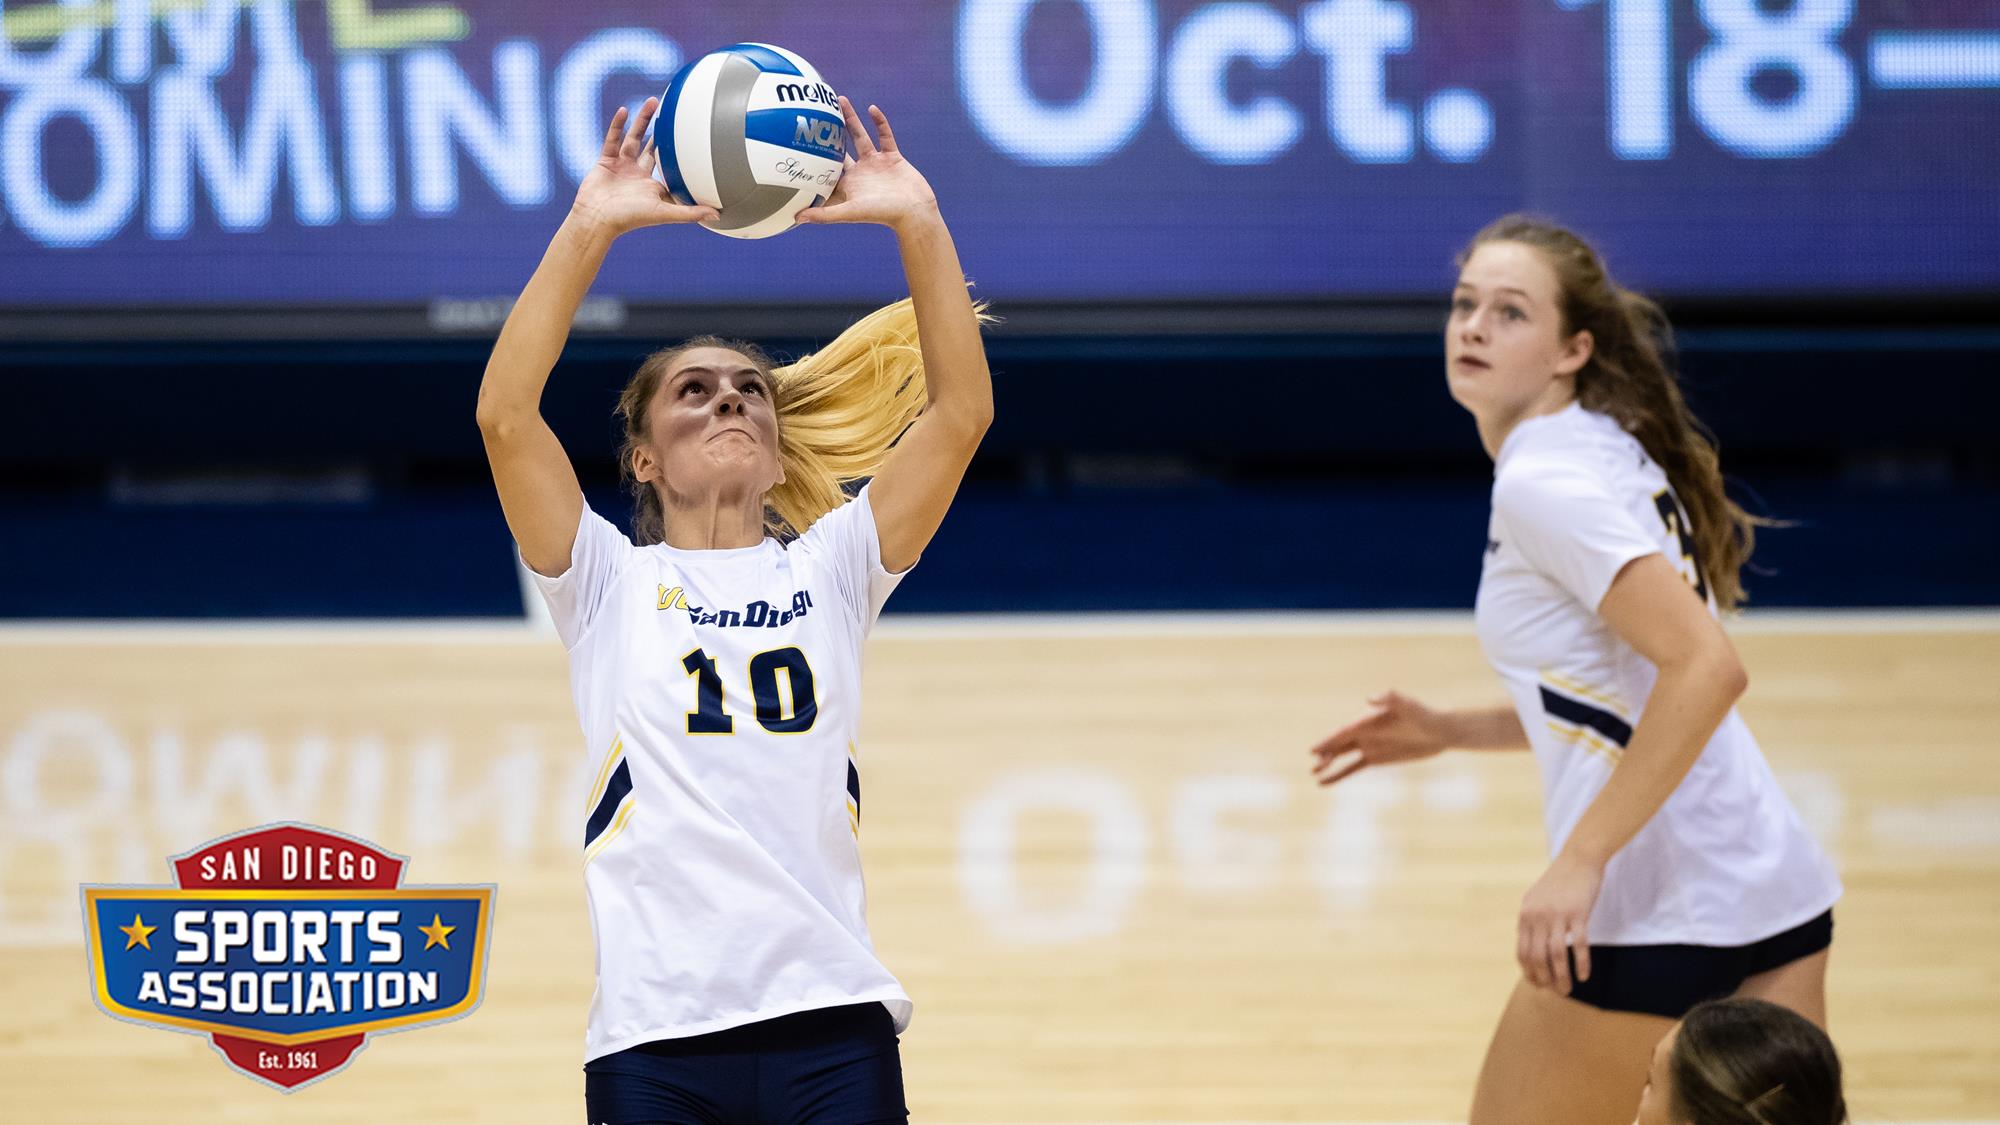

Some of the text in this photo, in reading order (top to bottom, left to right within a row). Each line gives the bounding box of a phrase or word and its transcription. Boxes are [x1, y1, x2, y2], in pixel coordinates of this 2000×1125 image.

[776, 83, 840, 111] molte
[955, 0, 1497, 166] Oct.
[775, 157, 814, 182] Super
[681, 645, 818, 736] 10
